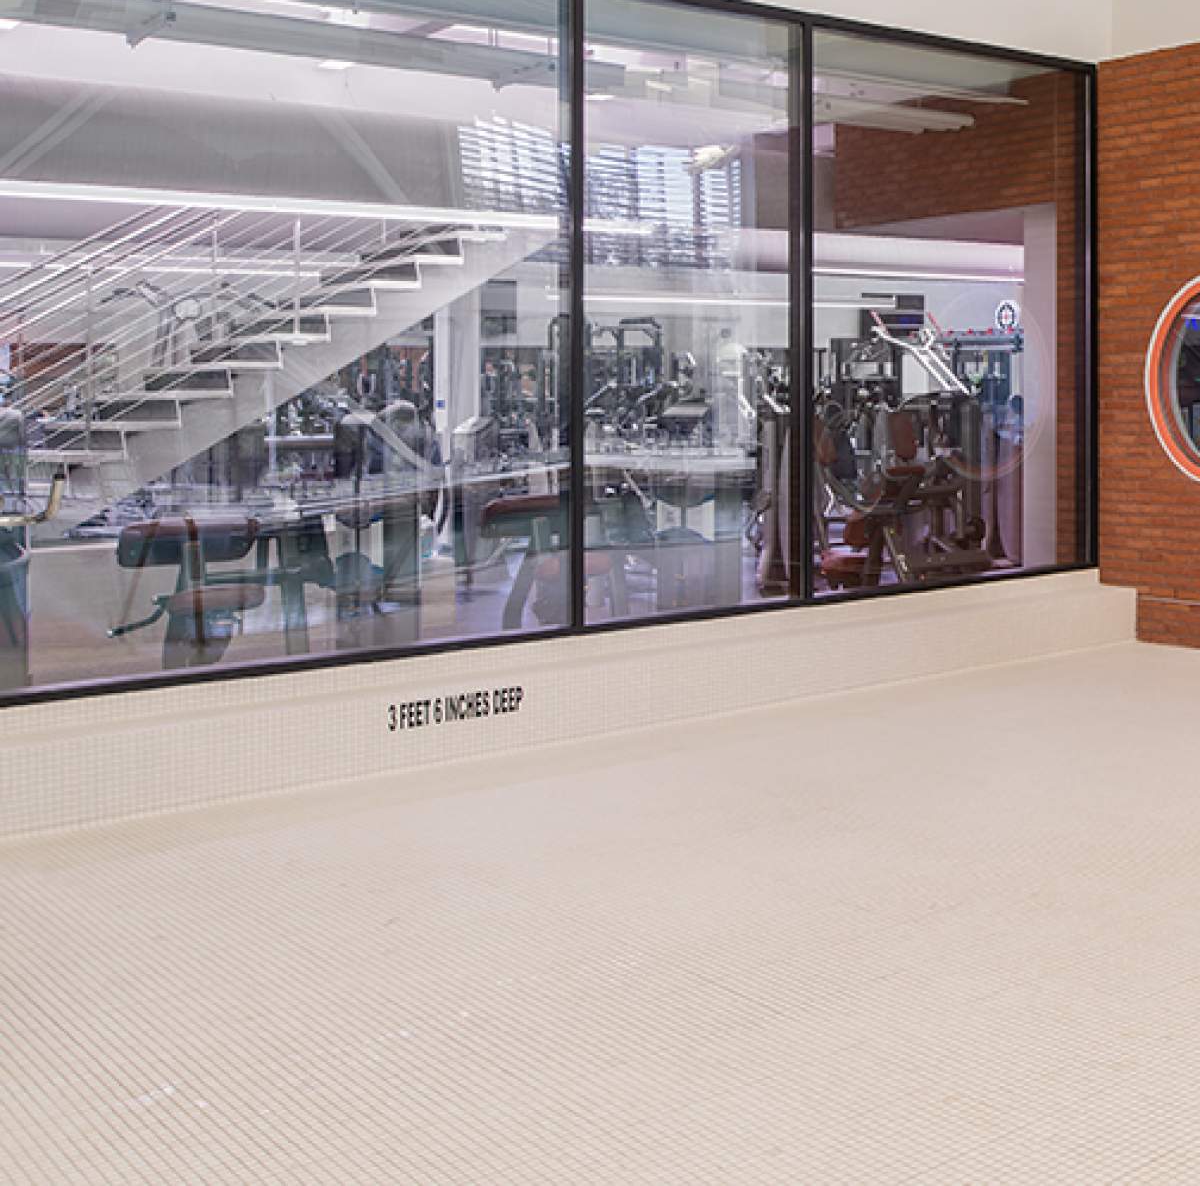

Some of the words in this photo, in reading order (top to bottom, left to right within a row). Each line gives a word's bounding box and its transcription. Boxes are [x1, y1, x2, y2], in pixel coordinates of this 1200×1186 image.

[387, 704, 397, 732] 3
[400, 699, 431, 730] FEET
[433, 697, 443, 725] 6
[445, 690, 490, 722] INCHES
[493, 685, 524, 715] DEEP
